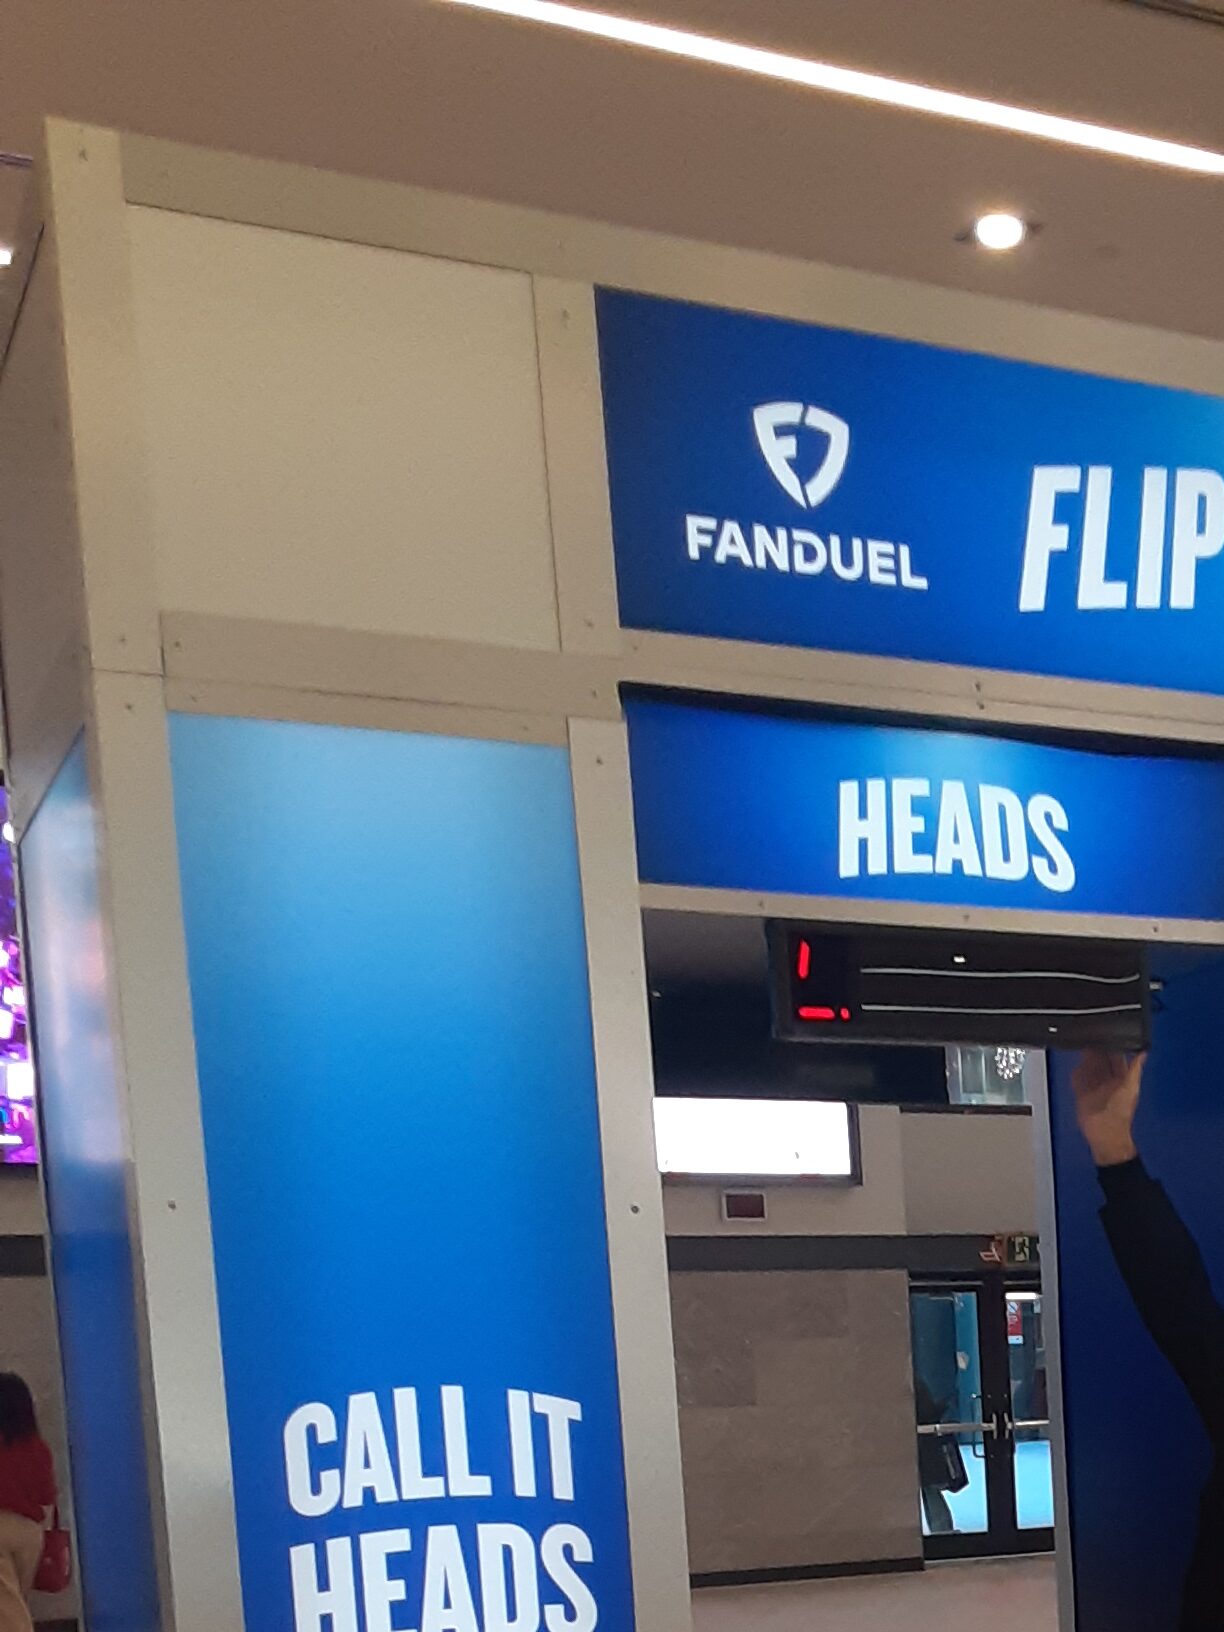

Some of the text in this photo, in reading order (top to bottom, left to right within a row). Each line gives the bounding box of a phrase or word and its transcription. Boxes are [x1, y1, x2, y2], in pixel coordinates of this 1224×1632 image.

[685, 514, 928, 590] FANDUEL
[838, 777, 1076, 893] HEADS
[282, 1385, 582, 1517] CALL IT
